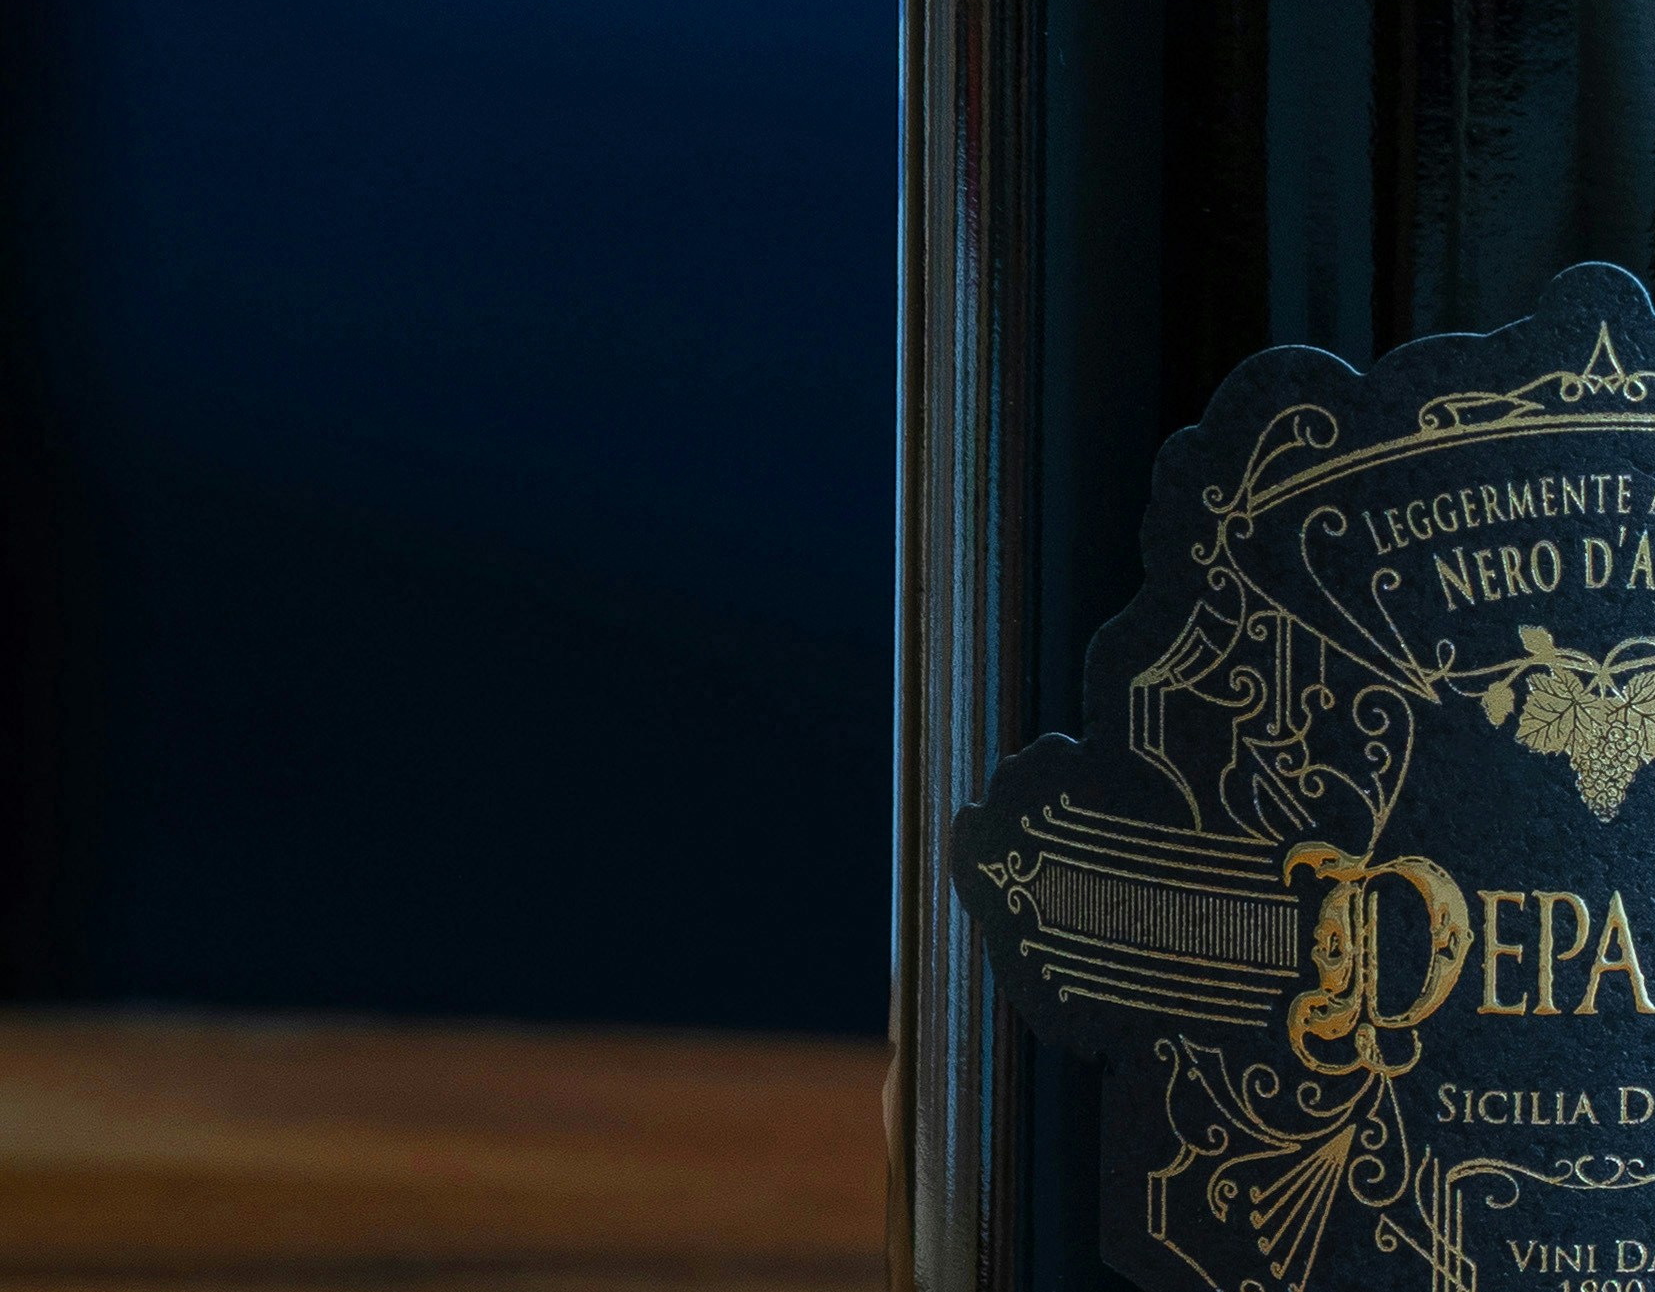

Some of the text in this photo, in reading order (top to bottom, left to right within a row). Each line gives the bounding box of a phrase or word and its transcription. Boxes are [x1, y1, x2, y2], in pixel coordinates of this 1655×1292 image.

[1363, 473, 1632, 555] LEGGERMENTE
[1433, 540, 1562, 611] NERO
[1438, 1083, 1600, 1125] SICILIA
[1506, 1239, 1598, 1273] VINI
